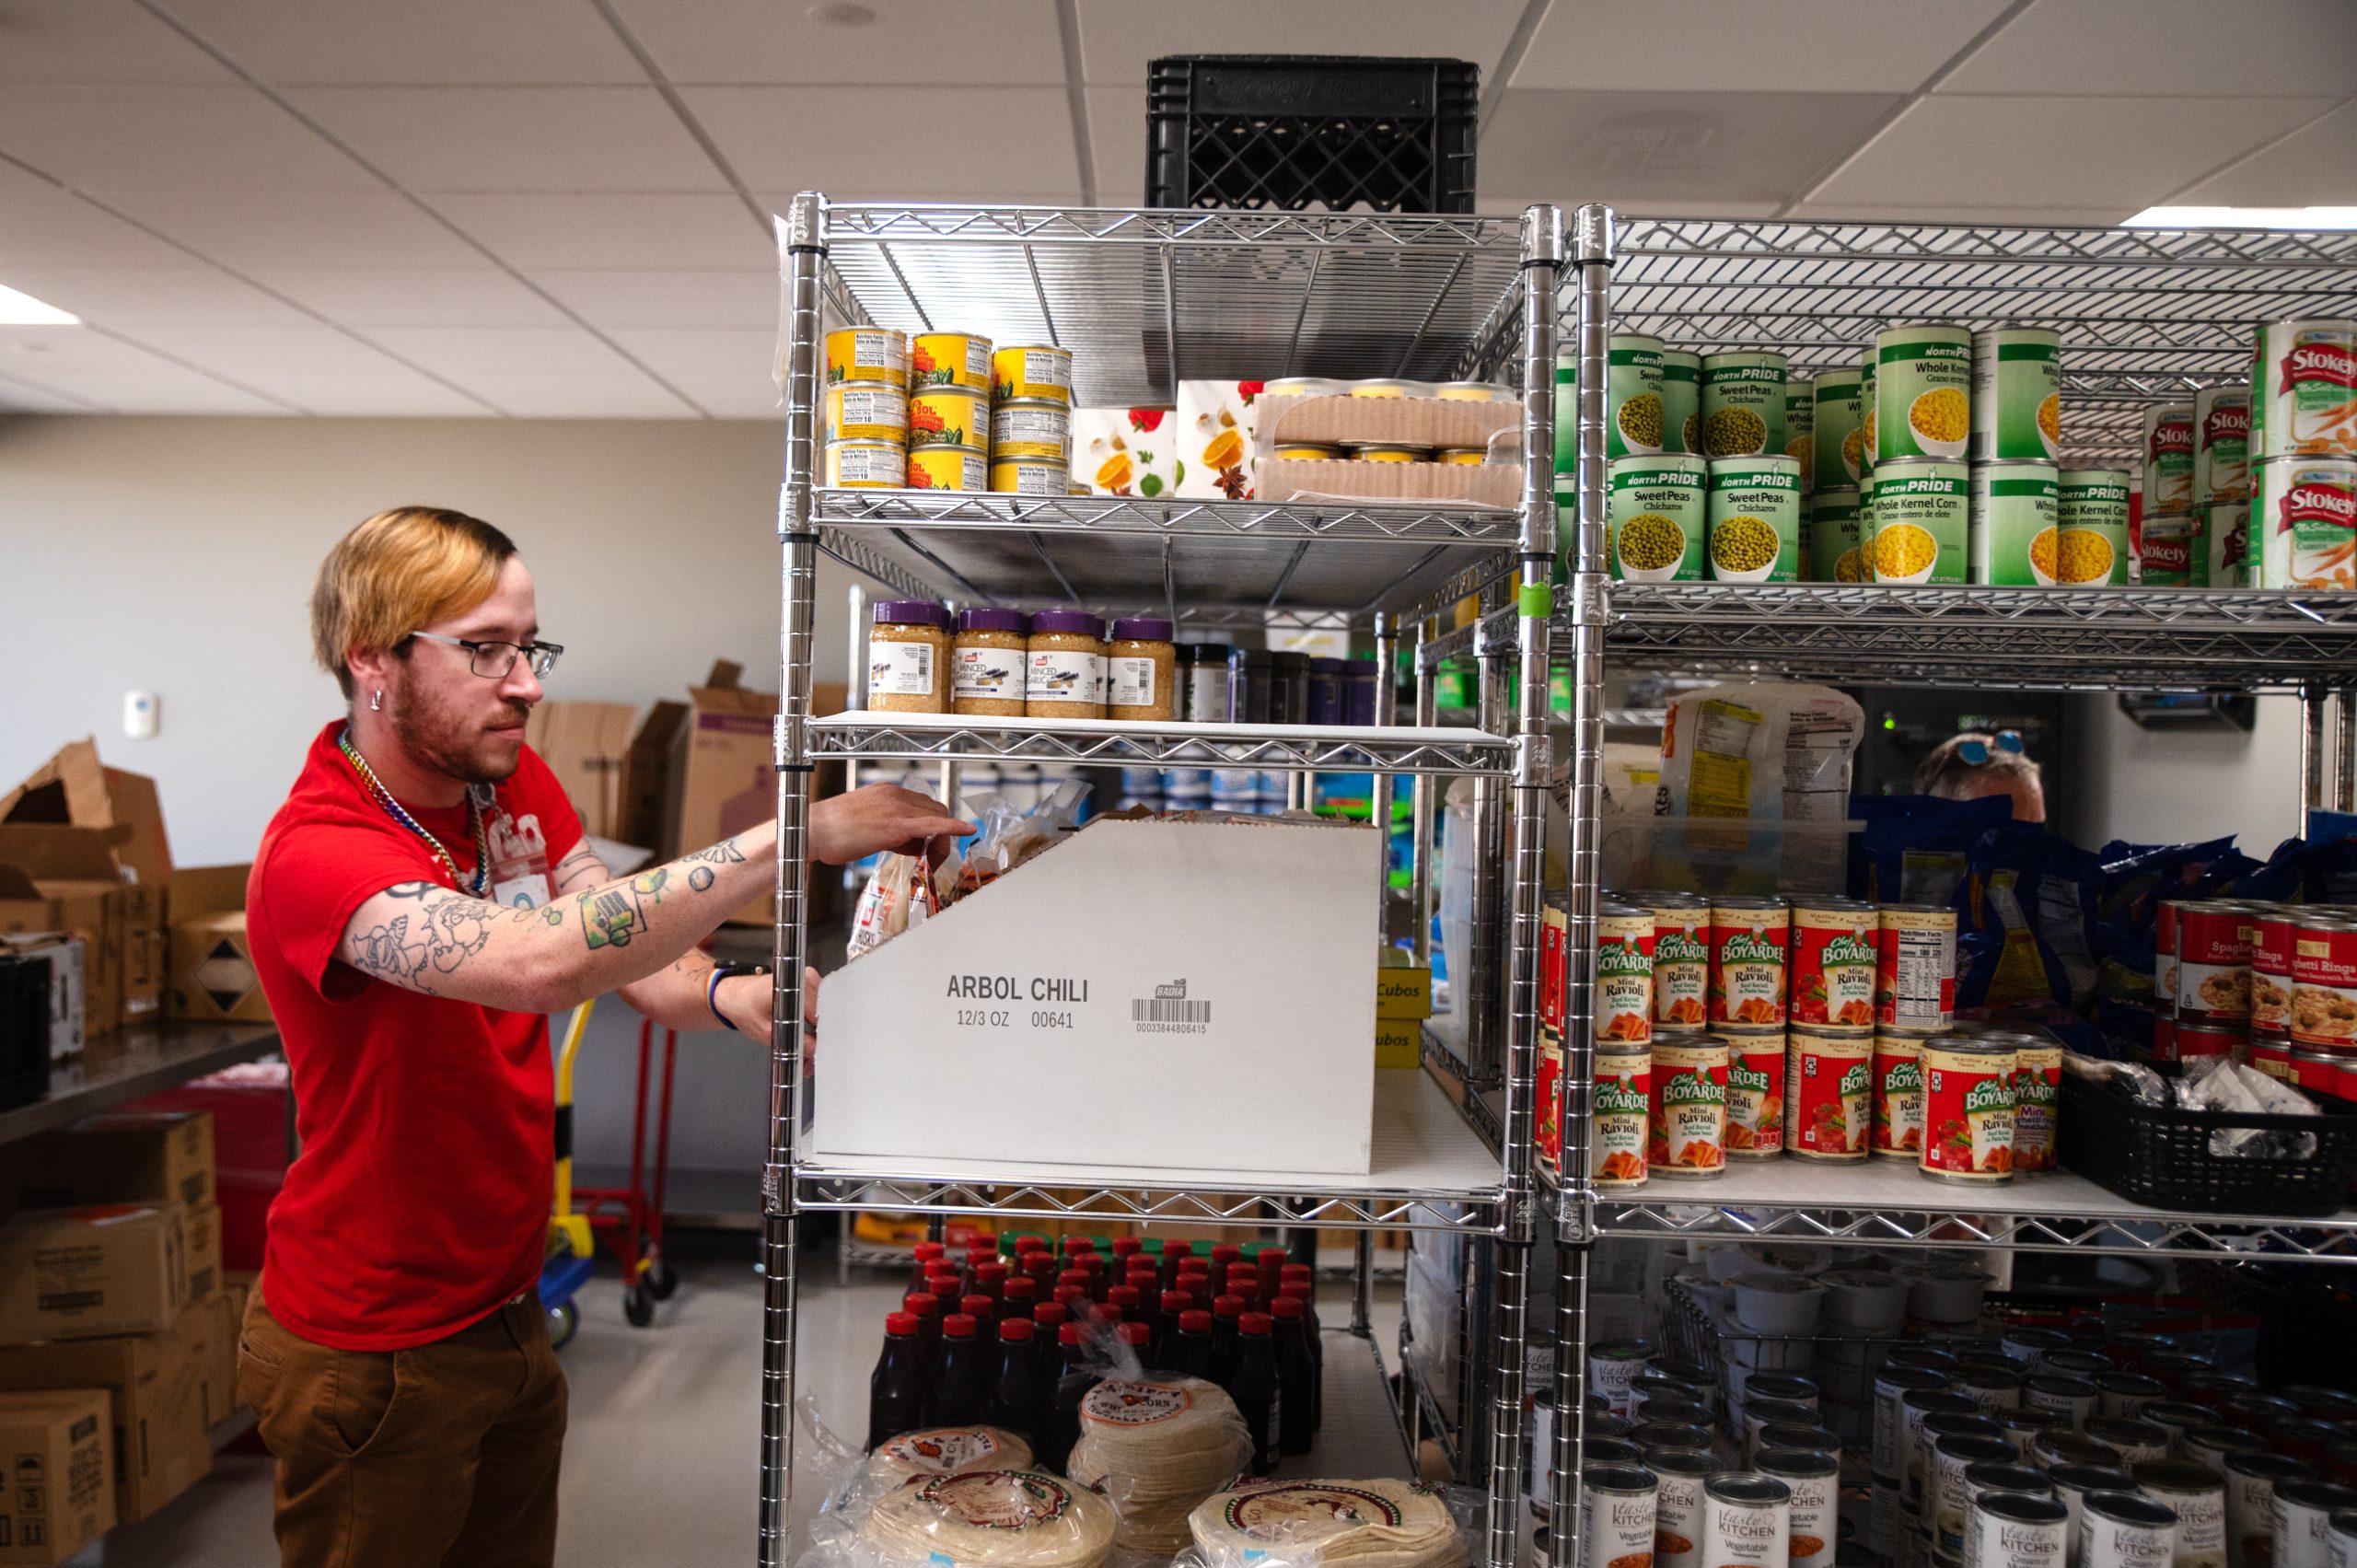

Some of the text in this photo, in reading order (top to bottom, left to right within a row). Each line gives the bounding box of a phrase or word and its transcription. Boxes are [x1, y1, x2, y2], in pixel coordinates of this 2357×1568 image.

[1916, 363, 1948, 373] Whole
[1713, 368, 1779, 381] NORTH PRIDE
[1719, 385, 1771, 396] Sweet Peas
[1628, 473, 1698, 485] NORTH PRIDE
[1721, 474, 1793, 487] NORTH PRIDE
[1880, 481, 1954, 494] NORTH PRIDE
[2087, 487, 2126, 500] PRIDE
[1634, 491, 1689, 502] Sweet Peas
[1727, 492, 1783, 504] Sweet Peas
[1875, 498, 1957, 511] Whole Kernel Corn
[2080, 505, 2111, 516] Kernel
[1881, 510, 1898, 519] Grano
[1924, 510, 1933, 518] de
[1934, 510, 1950, 518] elote
[959, 663, 986, 672] MINCED
[1030, 667, 1057, 676] MINCED
[957, 673, 976, 682] GARLIC
[1027, 675, 1047, 685] GARLIC
[1660, 935, 1682, 947] Chef
[1727, 935, 1750, 947] Chef
[1830, 936, 1852, 947] Chef
[1598, 944, 1622, 956] Chef
[1721, 946, 1784, 964] BOYARDEE
[2258, 951, 2282, 961] Rings
[2321, 961, 2357, 975] Rings
[1617, 978, 1635, 986] Mini
[1667, 971, 1701, 982] Ravioli
[1735, 971, 1773, 983] Ravioli
[1837, 973, 1871, 984] Ravioli
[946, 975, 1088, 1002] ARBOL CHILI
[1156, 986, 1184, 997] BADIA
[1376, 983, 1420, 997] Cubos
[1606, 984, 1643, 997] Ravioli
[958, 1010, 1074, 1028] 12/3 OZ 00641
[1136, 1023, 1206, 1034] 00033844806415
[1892, 1063, 1914, 1074] Chef
[1669, 1074, 1694, 1086] Chef
[1975, 1081, 1996, 1093] Chef
[1689, 1107, 1707, 1115] Mini
[2020, 1105, 2046, 1117] Mini
[1678, 1112, 1716, 1124] Ravioli
[1600, 1122, 1639, 1135] Ravioli
[1982, 1120, 2013, 1132] Ravioli
[1618, 1498, 1650, 1516] tasty
[1724, 1509, 1761, 1527] tasty
[1719, 1518, 1775, 1537] KITCHEN
[1724, 1539, 1769, 1552] Vegetable
[2002, 1539, 2058, 1553] KITCHEN
[2011, 1554, 2037, 1563] Cream
